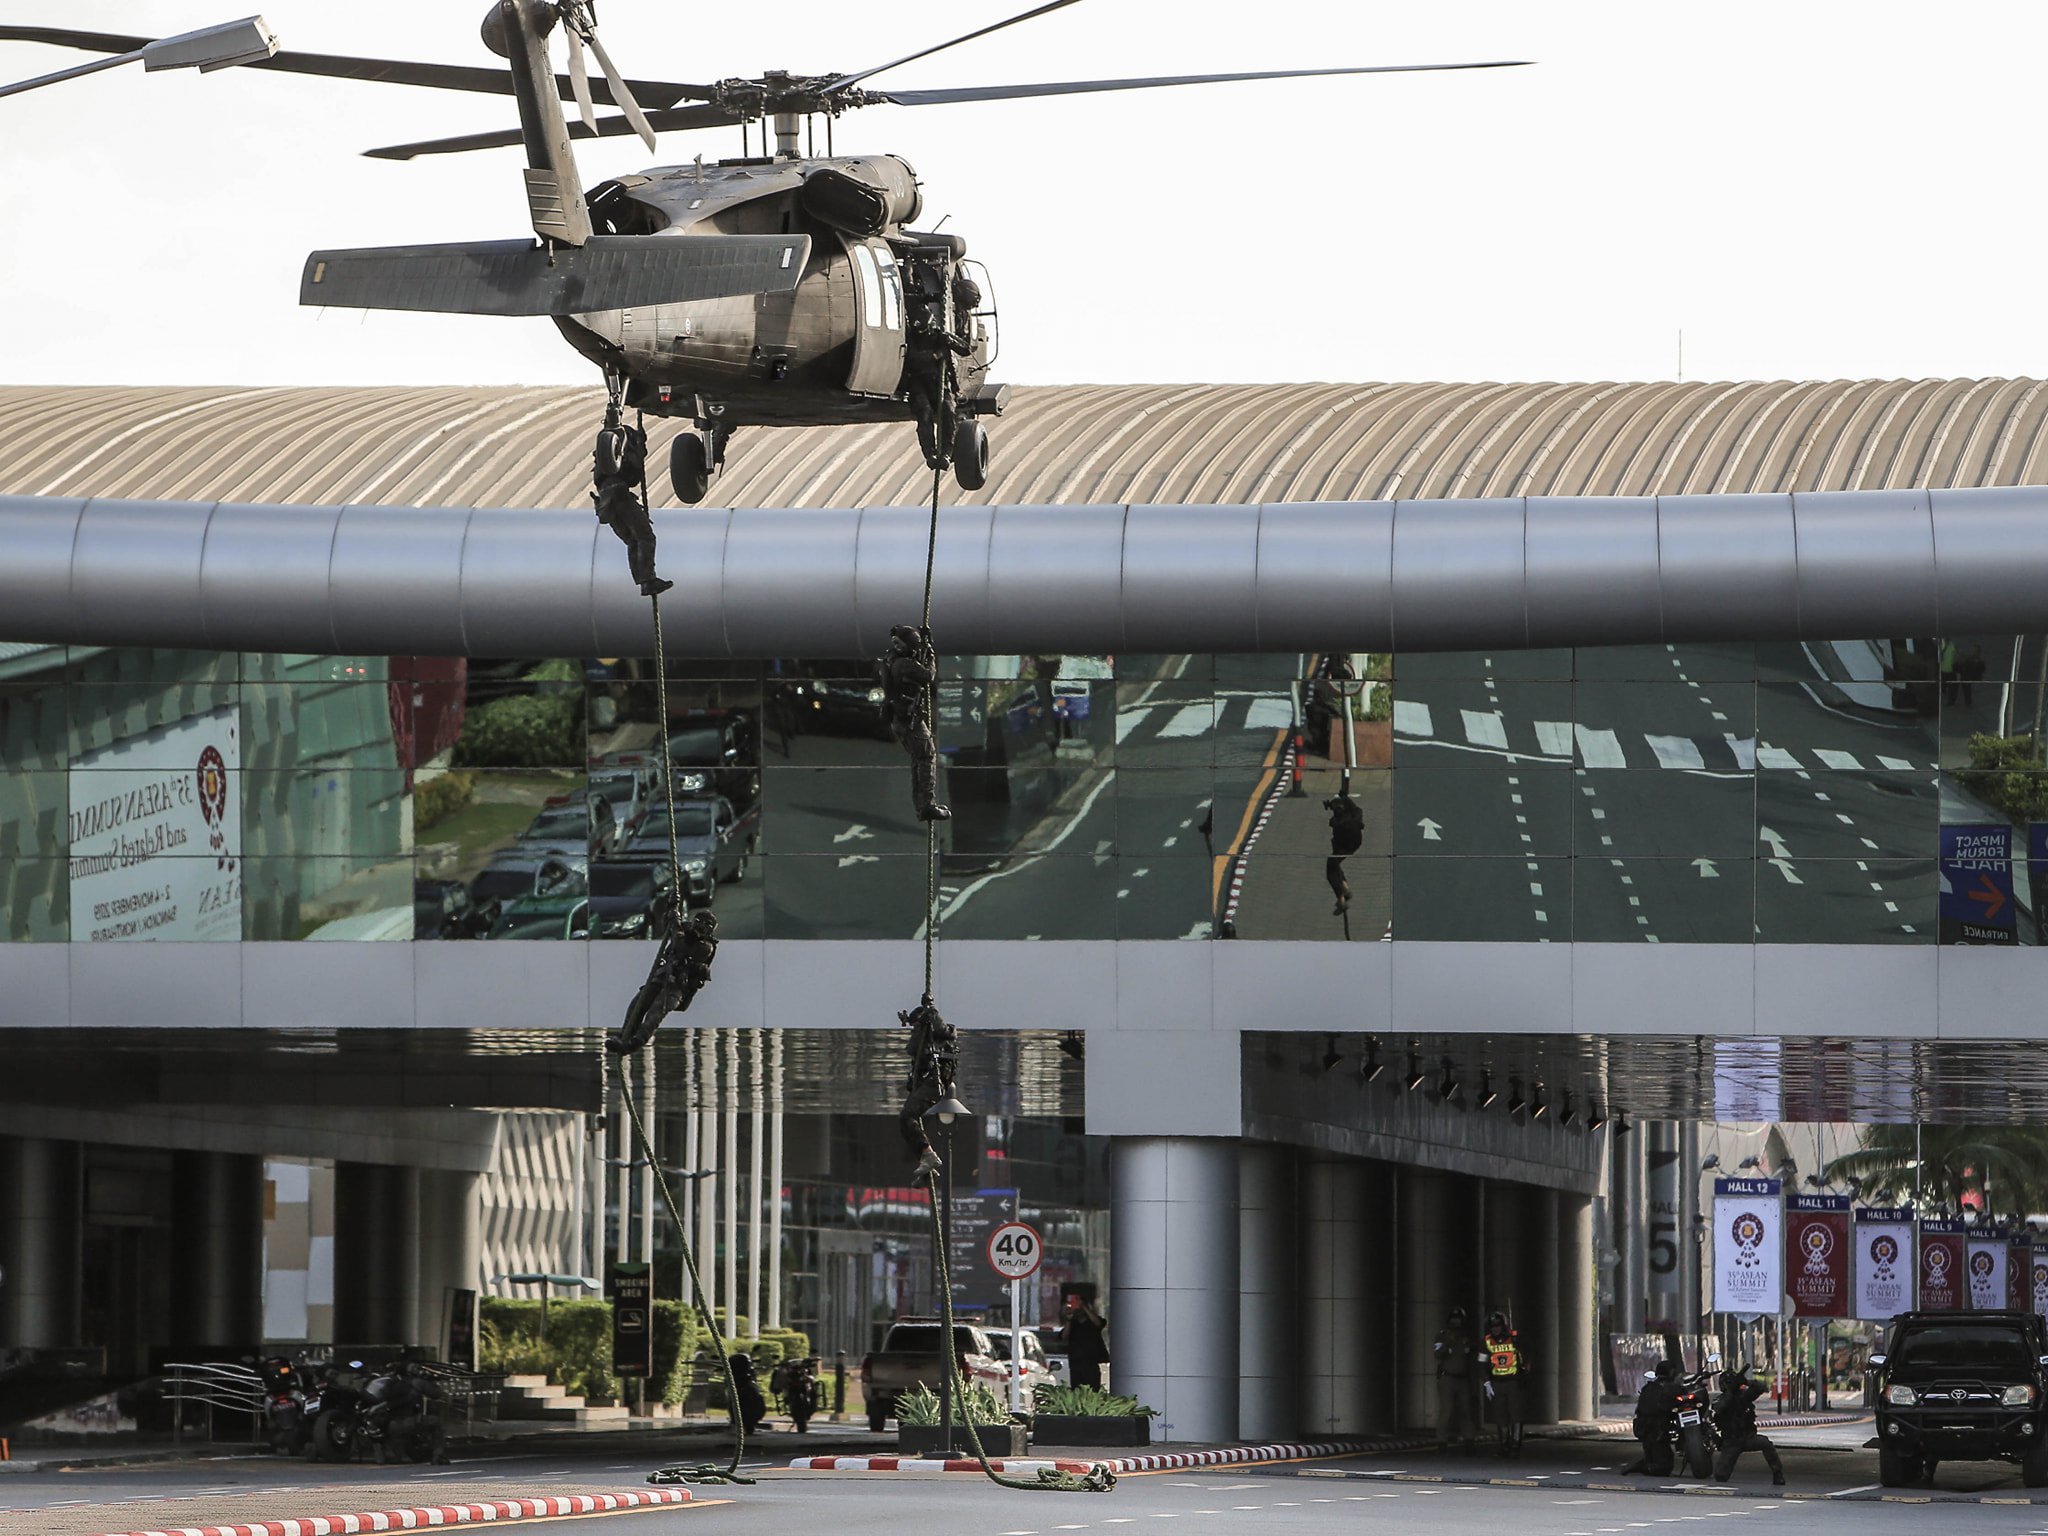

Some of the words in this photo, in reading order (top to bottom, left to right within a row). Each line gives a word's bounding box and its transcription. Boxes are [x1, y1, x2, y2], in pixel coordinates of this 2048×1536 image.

[1728, 1182, 1754, 1193] HALL
[1757, 1182, 1769, 1193] 12
[1798, 1198, 1823, 1208] HALL
[1826, 1199, 1836, 1208] 11
[1924, 1223, 1945, 1231] HALL
[1947, 1223, 1952, 1231] 9
[996, 1234, 1034, 1256] 40
[1650, 1222, 1677, 1274] 5
[1740, 1271, 1768, 1279] ASEAN
[614, 1278, 649, 1288] SMOKING
[1727, 1279, 1767, 1288] SUMMIT
[1809, 1277, 1836, 1285] ASEAN
[621, 1288, 642, 1298] AREA
[1797, 1285, 1835, 1293] SUMMIT
